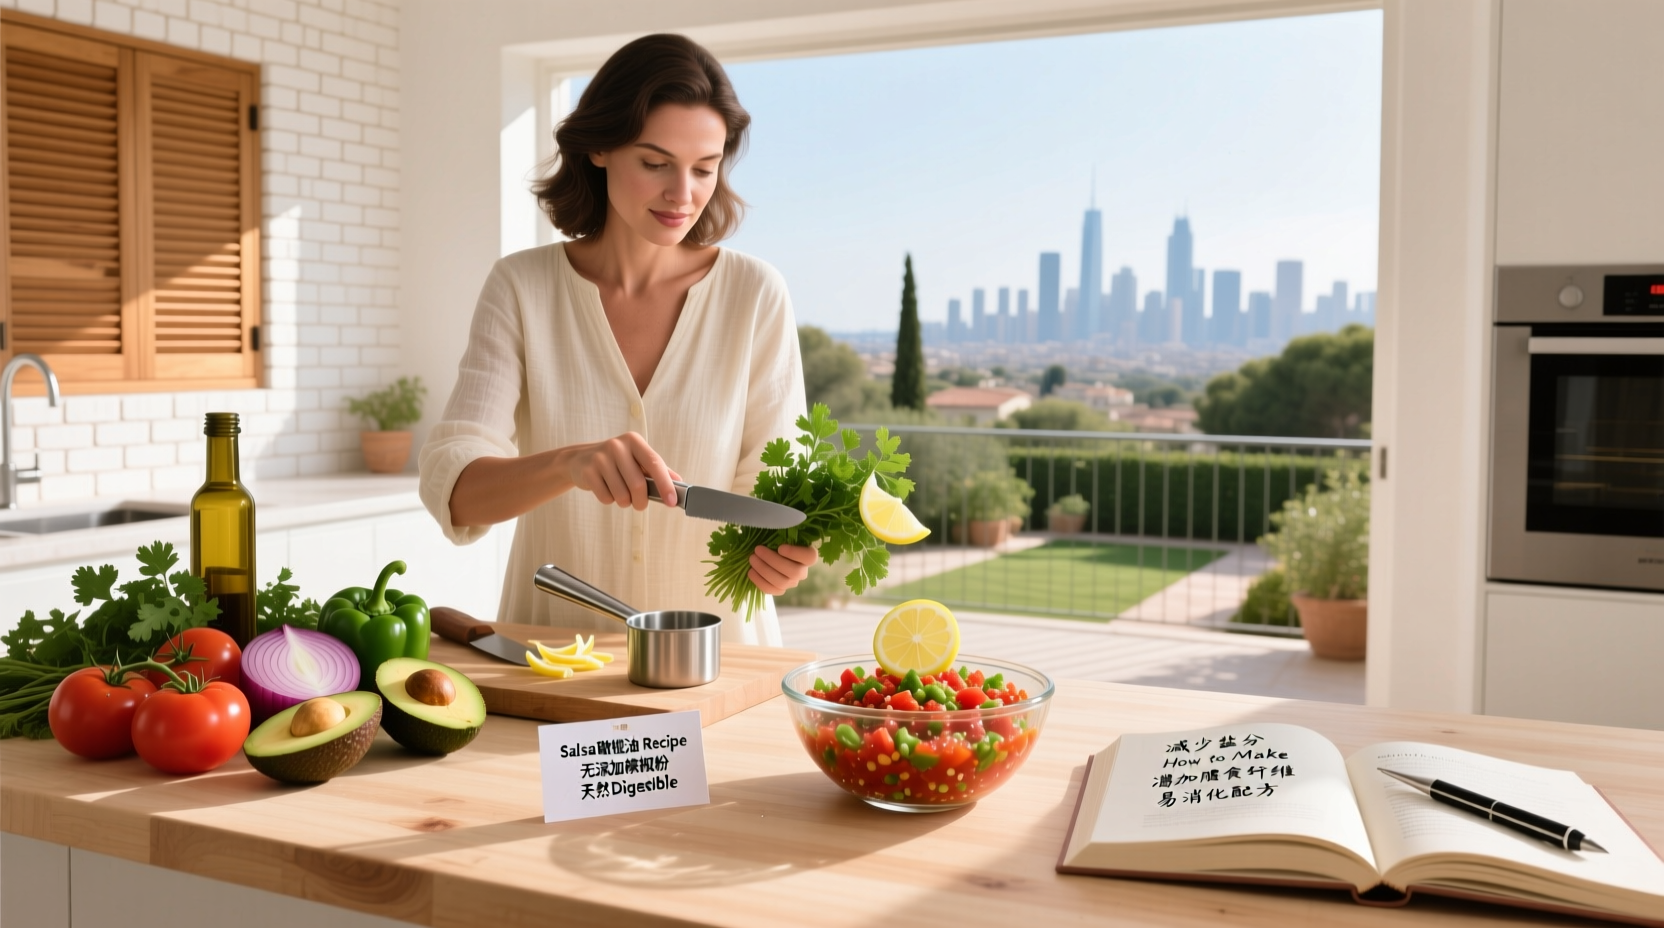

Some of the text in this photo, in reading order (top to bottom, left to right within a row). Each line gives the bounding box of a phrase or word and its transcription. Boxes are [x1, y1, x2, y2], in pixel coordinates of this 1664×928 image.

[642, 734, 688, 753] Recipe
[1162, 757, 1201, 769] How
[1231, 748, 1289, 762] Make
